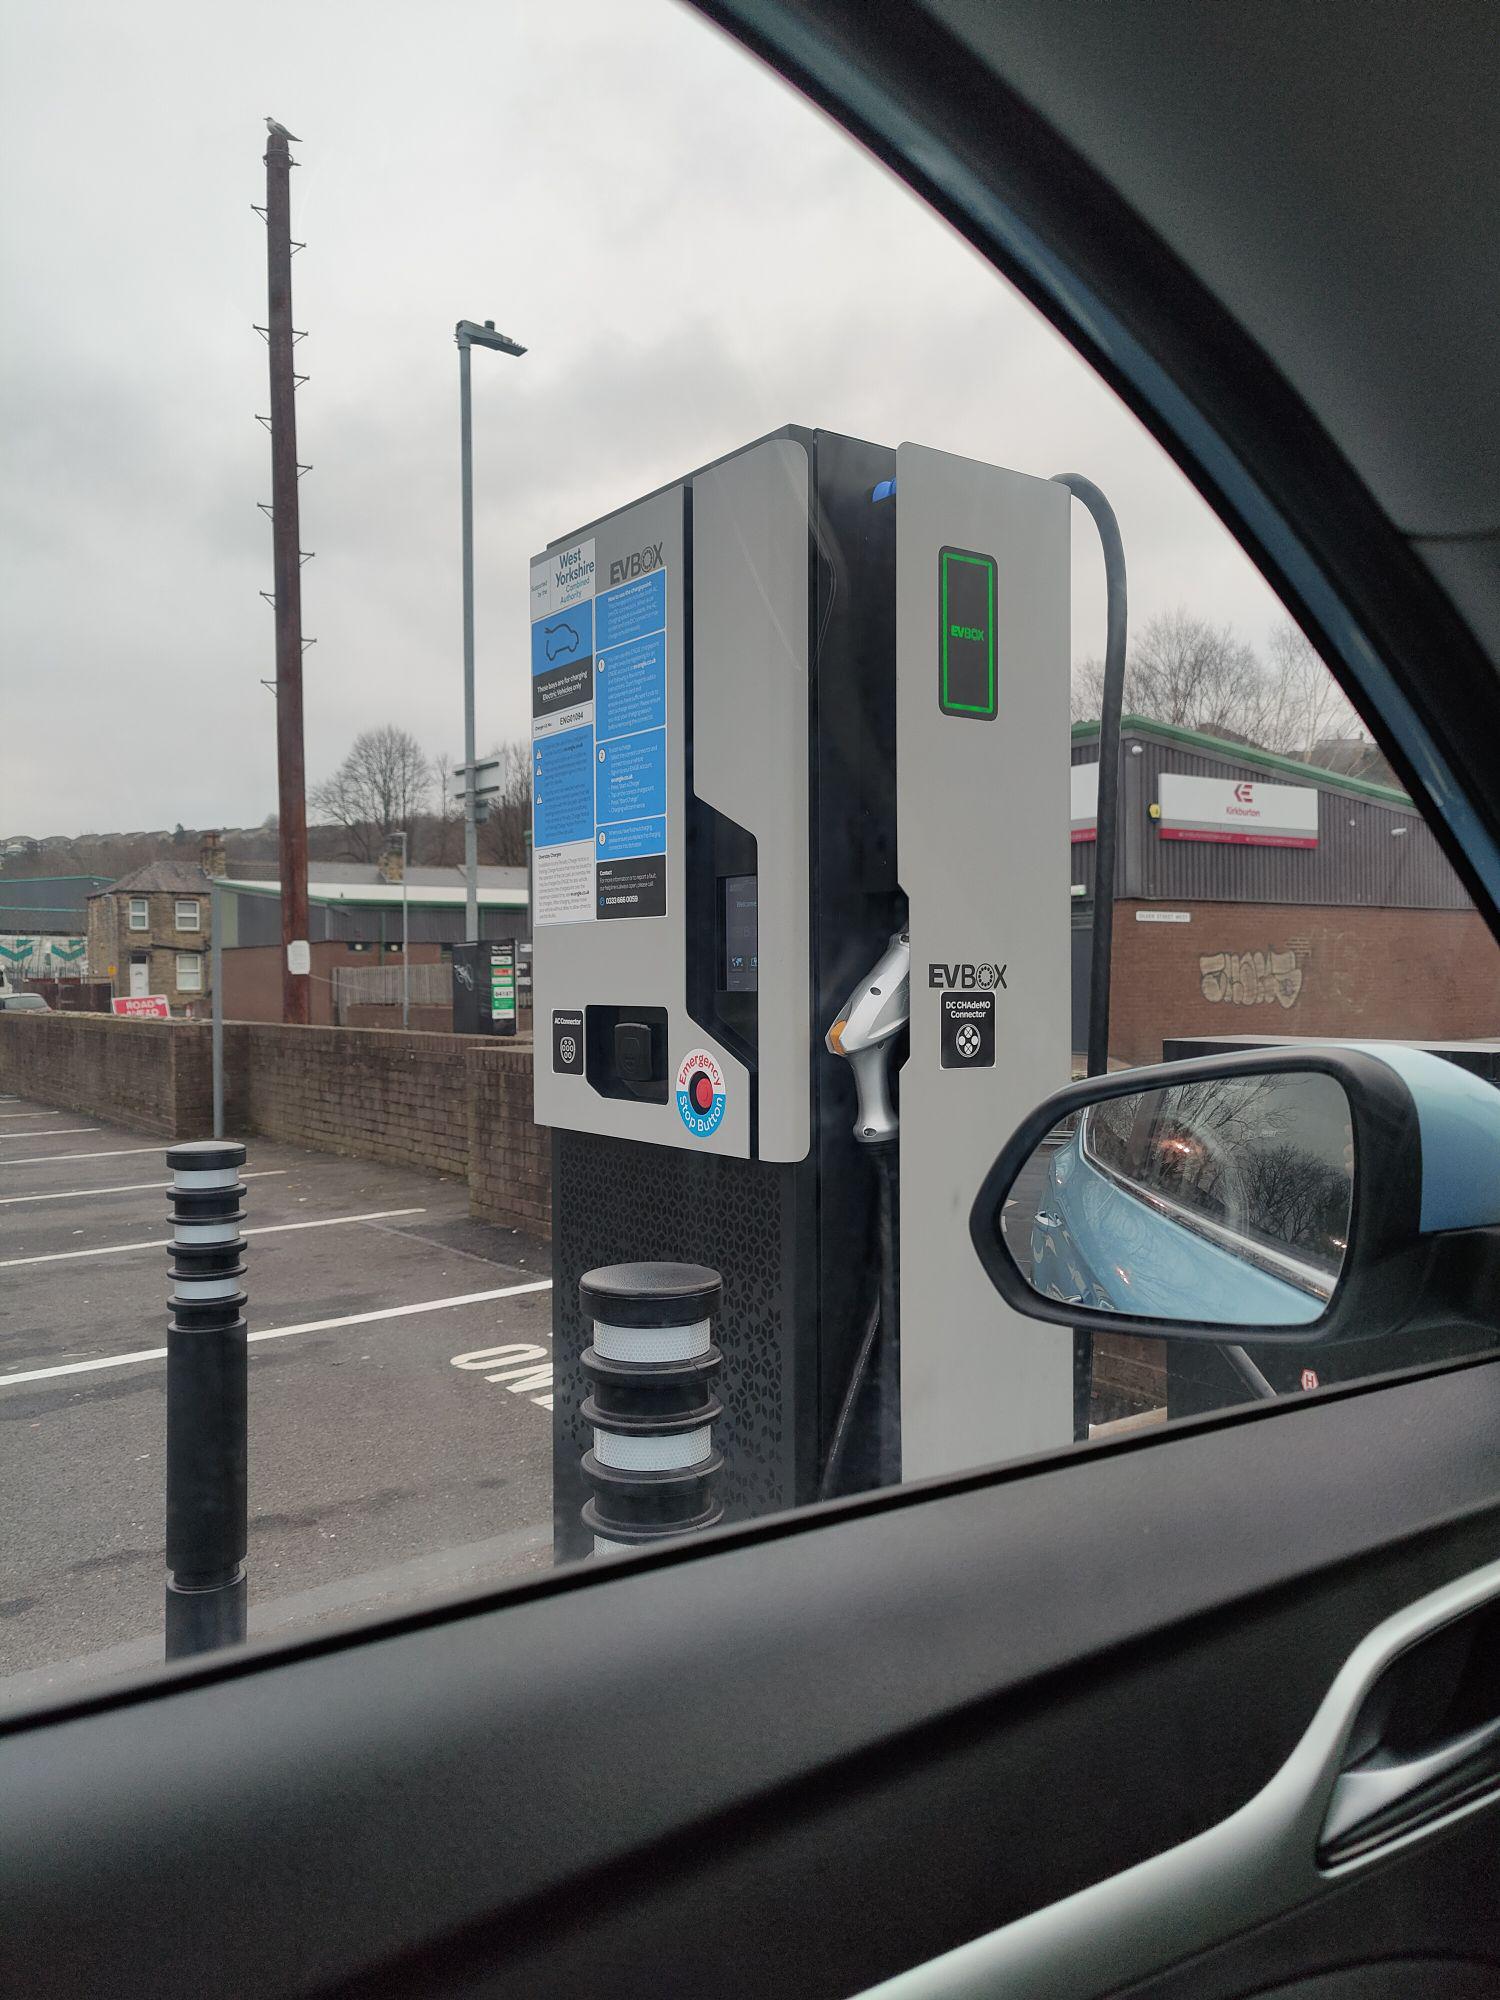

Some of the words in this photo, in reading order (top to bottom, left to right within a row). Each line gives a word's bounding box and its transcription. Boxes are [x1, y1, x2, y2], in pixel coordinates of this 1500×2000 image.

[559, 547, 582, 569] West
[609, 541, 664, 585] EVBOX
[555, 560, 595, 588] Yorkshire
[950, 624, 984, 641] EVBOX
[1226, 806, 1260, 817] Kirkburton
[928, 963, 1007, 990] EVBOX
[126, 1000, 155, 1010] ROAD
[945, 1001, 956, 1009] DC
[957, 1001, 991, 1009] CHAdeMO
[950, 1010, 986, 1019] Connector
[679, 1054, 721, 1086] Emergency
[680, 1095, 696, 1128] Stop
[697, 1098, 723, 1131] Button
